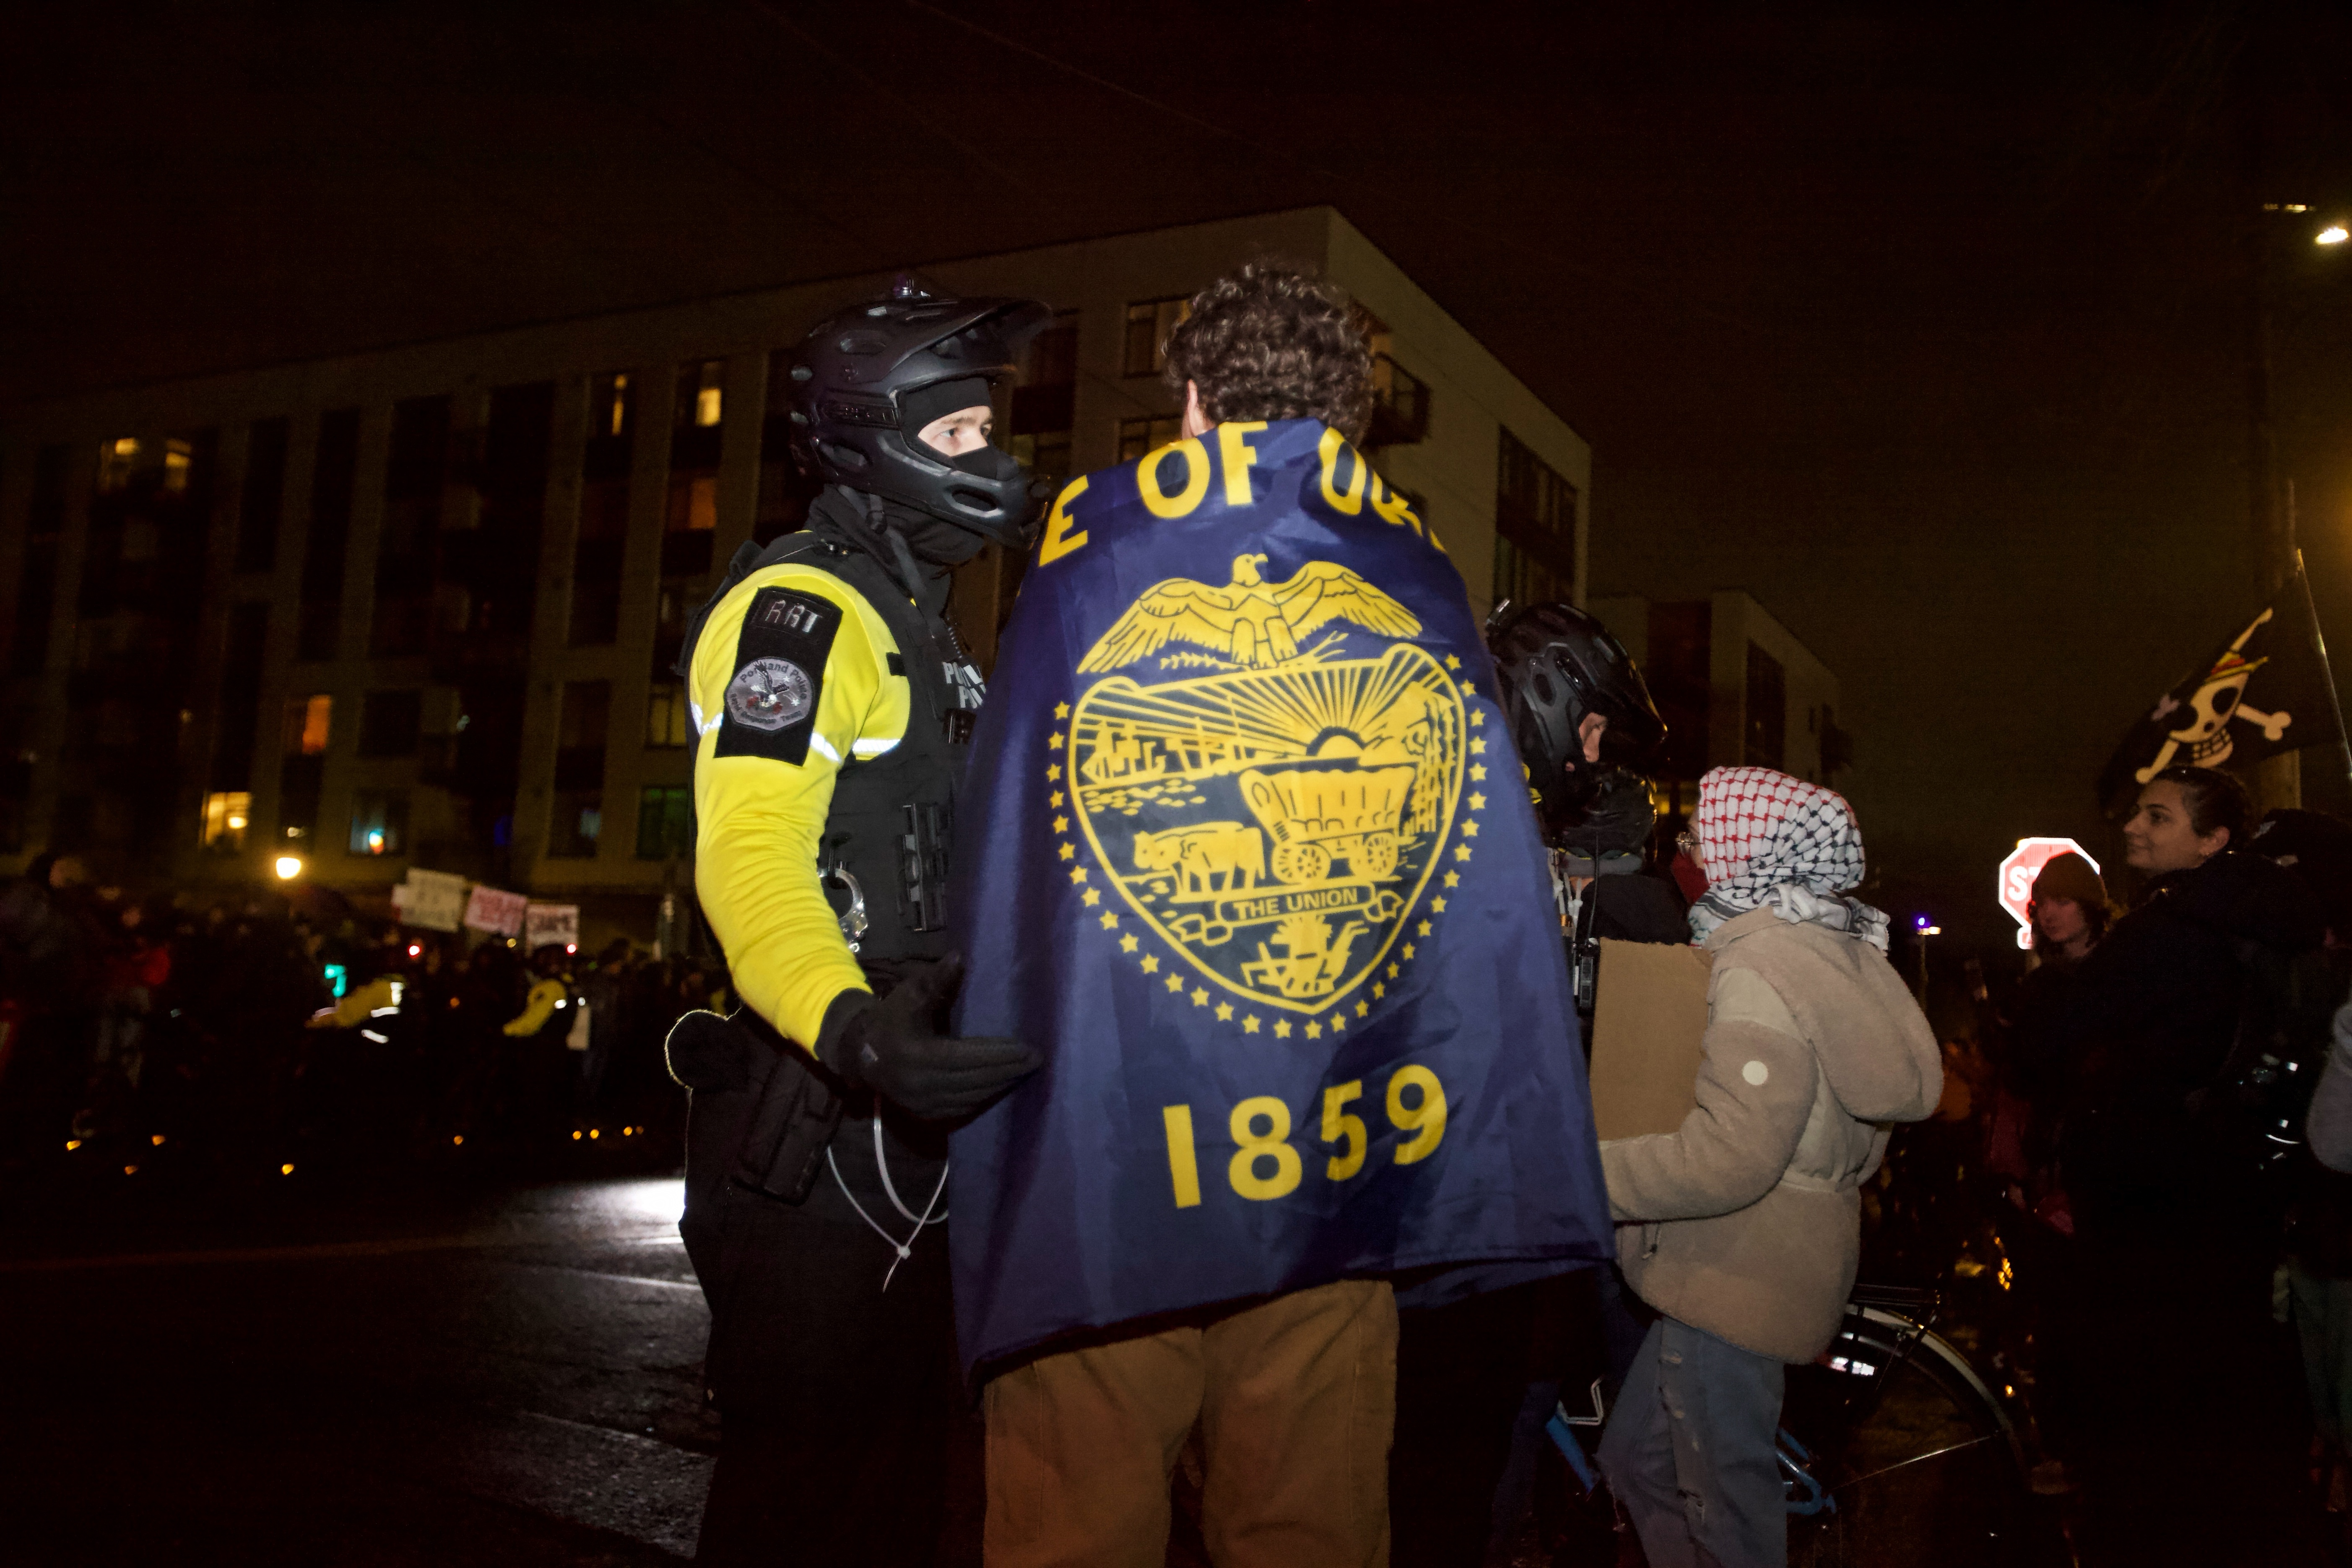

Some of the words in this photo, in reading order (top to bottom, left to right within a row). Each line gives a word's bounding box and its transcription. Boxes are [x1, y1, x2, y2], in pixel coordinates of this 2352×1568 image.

[1136, 421, 1268, 519] OF
[1233, 897, 1280, 921] THE
[1286, 888, 1358, 912] UNION
[1162, 1064, 1448, 1209] 1859
